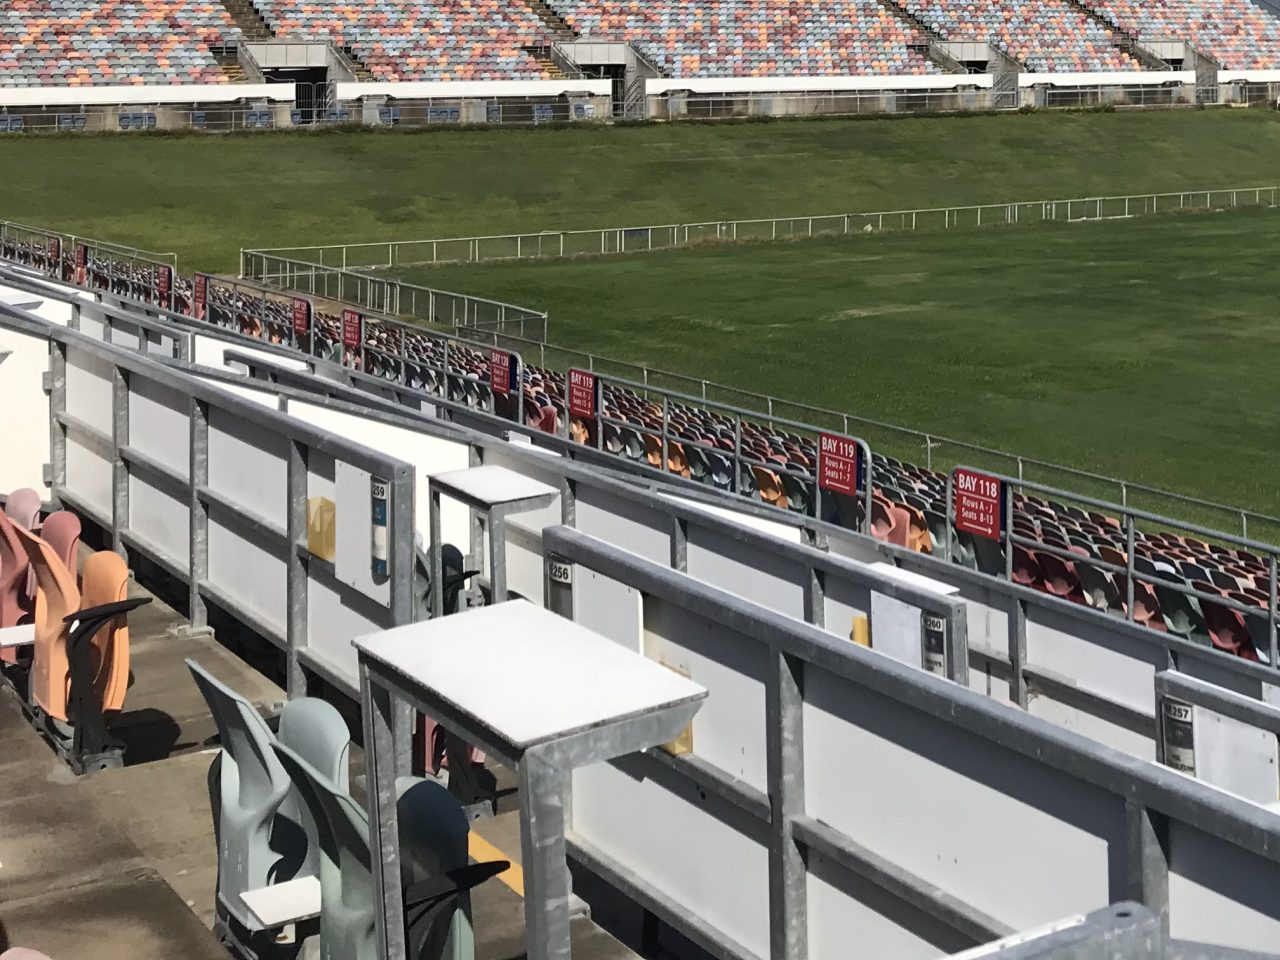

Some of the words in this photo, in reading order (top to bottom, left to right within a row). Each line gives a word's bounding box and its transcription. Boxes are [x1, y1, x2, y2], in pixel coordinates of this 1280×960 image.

[492, 351, 500, 364] BAY
[571, 371, 582, 385] BAY
[582, 375, 593, 389] 119
[822, 436, 837, 453] BAY
[839, 441, 854, 458] 119
[825, 456, 838, 469] Rows
[839, 460, 843, 470] A
[825, 467, 838, 479] Seats
[958, 473, 977, 492] BAY
[979, 479, 997, 498] 118
[962, 496, 978, 509] Rows
[979, 500, 984, 511] A
[989, 503, 993, 513] J
[961, 507, 977, 520] Seats
